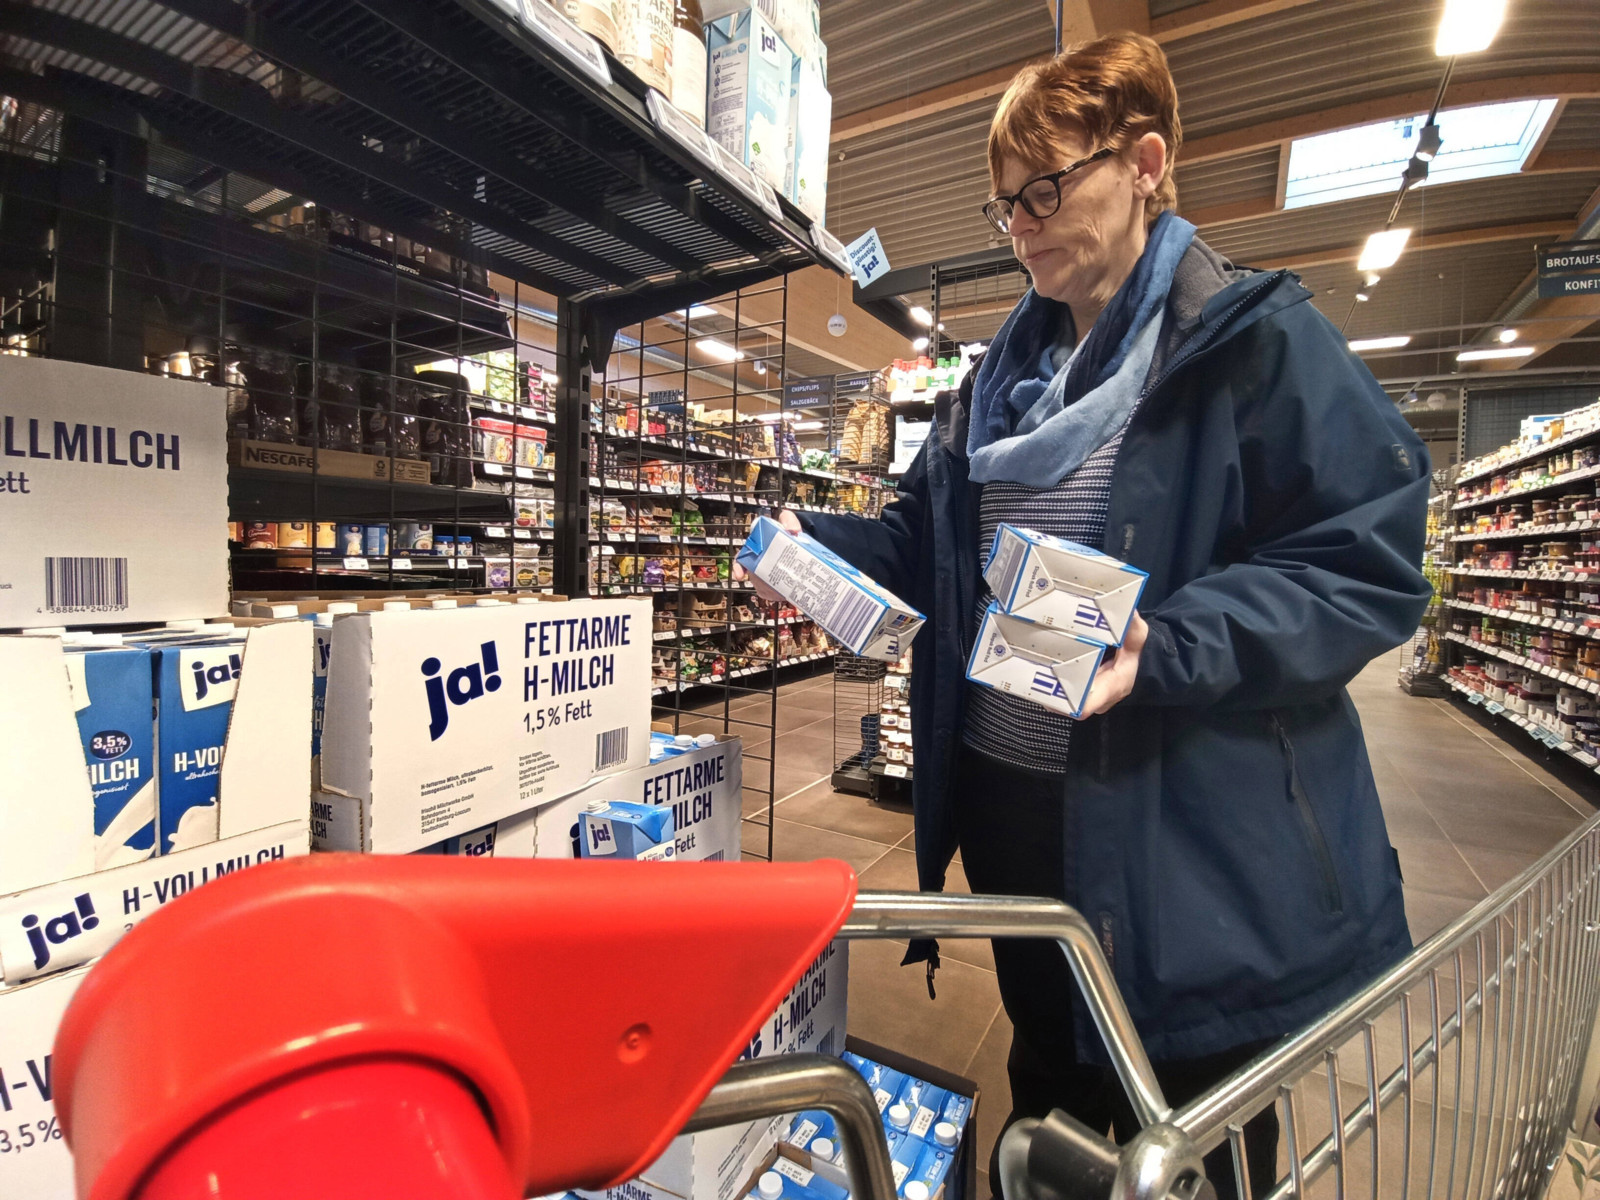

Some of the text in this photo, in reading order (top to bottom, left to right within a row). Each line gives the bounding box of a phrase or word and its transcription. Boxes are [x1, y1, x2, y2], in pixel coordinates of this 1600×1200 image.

[761, 27, 776, 52] ja!
[850, 235, 875, 259] Discount-
[855, 242, 877, 267] günstig?
[861, 255, 880, 279] ja!
[1565, 279, 1600, 290] KONFI
[791, 384, 820, 393] CHIPS/FLIPS
[790, 397, 819, 406] SALZGEBÄCK
[0, 415, 181, 471] LLMILCH
[524, 614, 631, 659] FETTARME
[192, 654, 242, 701] ja!
[524, 654, 614, 702] H-MILCH
[421, 640, 502, 742] ja!
[565, 700, 592, 723] Fett
[93, 735, 127, 750] 3,5%
[105, 746, 124, 755] FETT
[87, 758, 140, 786] ILCH
[644, 755, 725, 805] FETTARME
[590, 823, 611, 850] ja!
[675, 832, 696, 855] Fett
[21, 892, 100, 971] ja!
[773, 967, 827, 1051] H-MILCH
